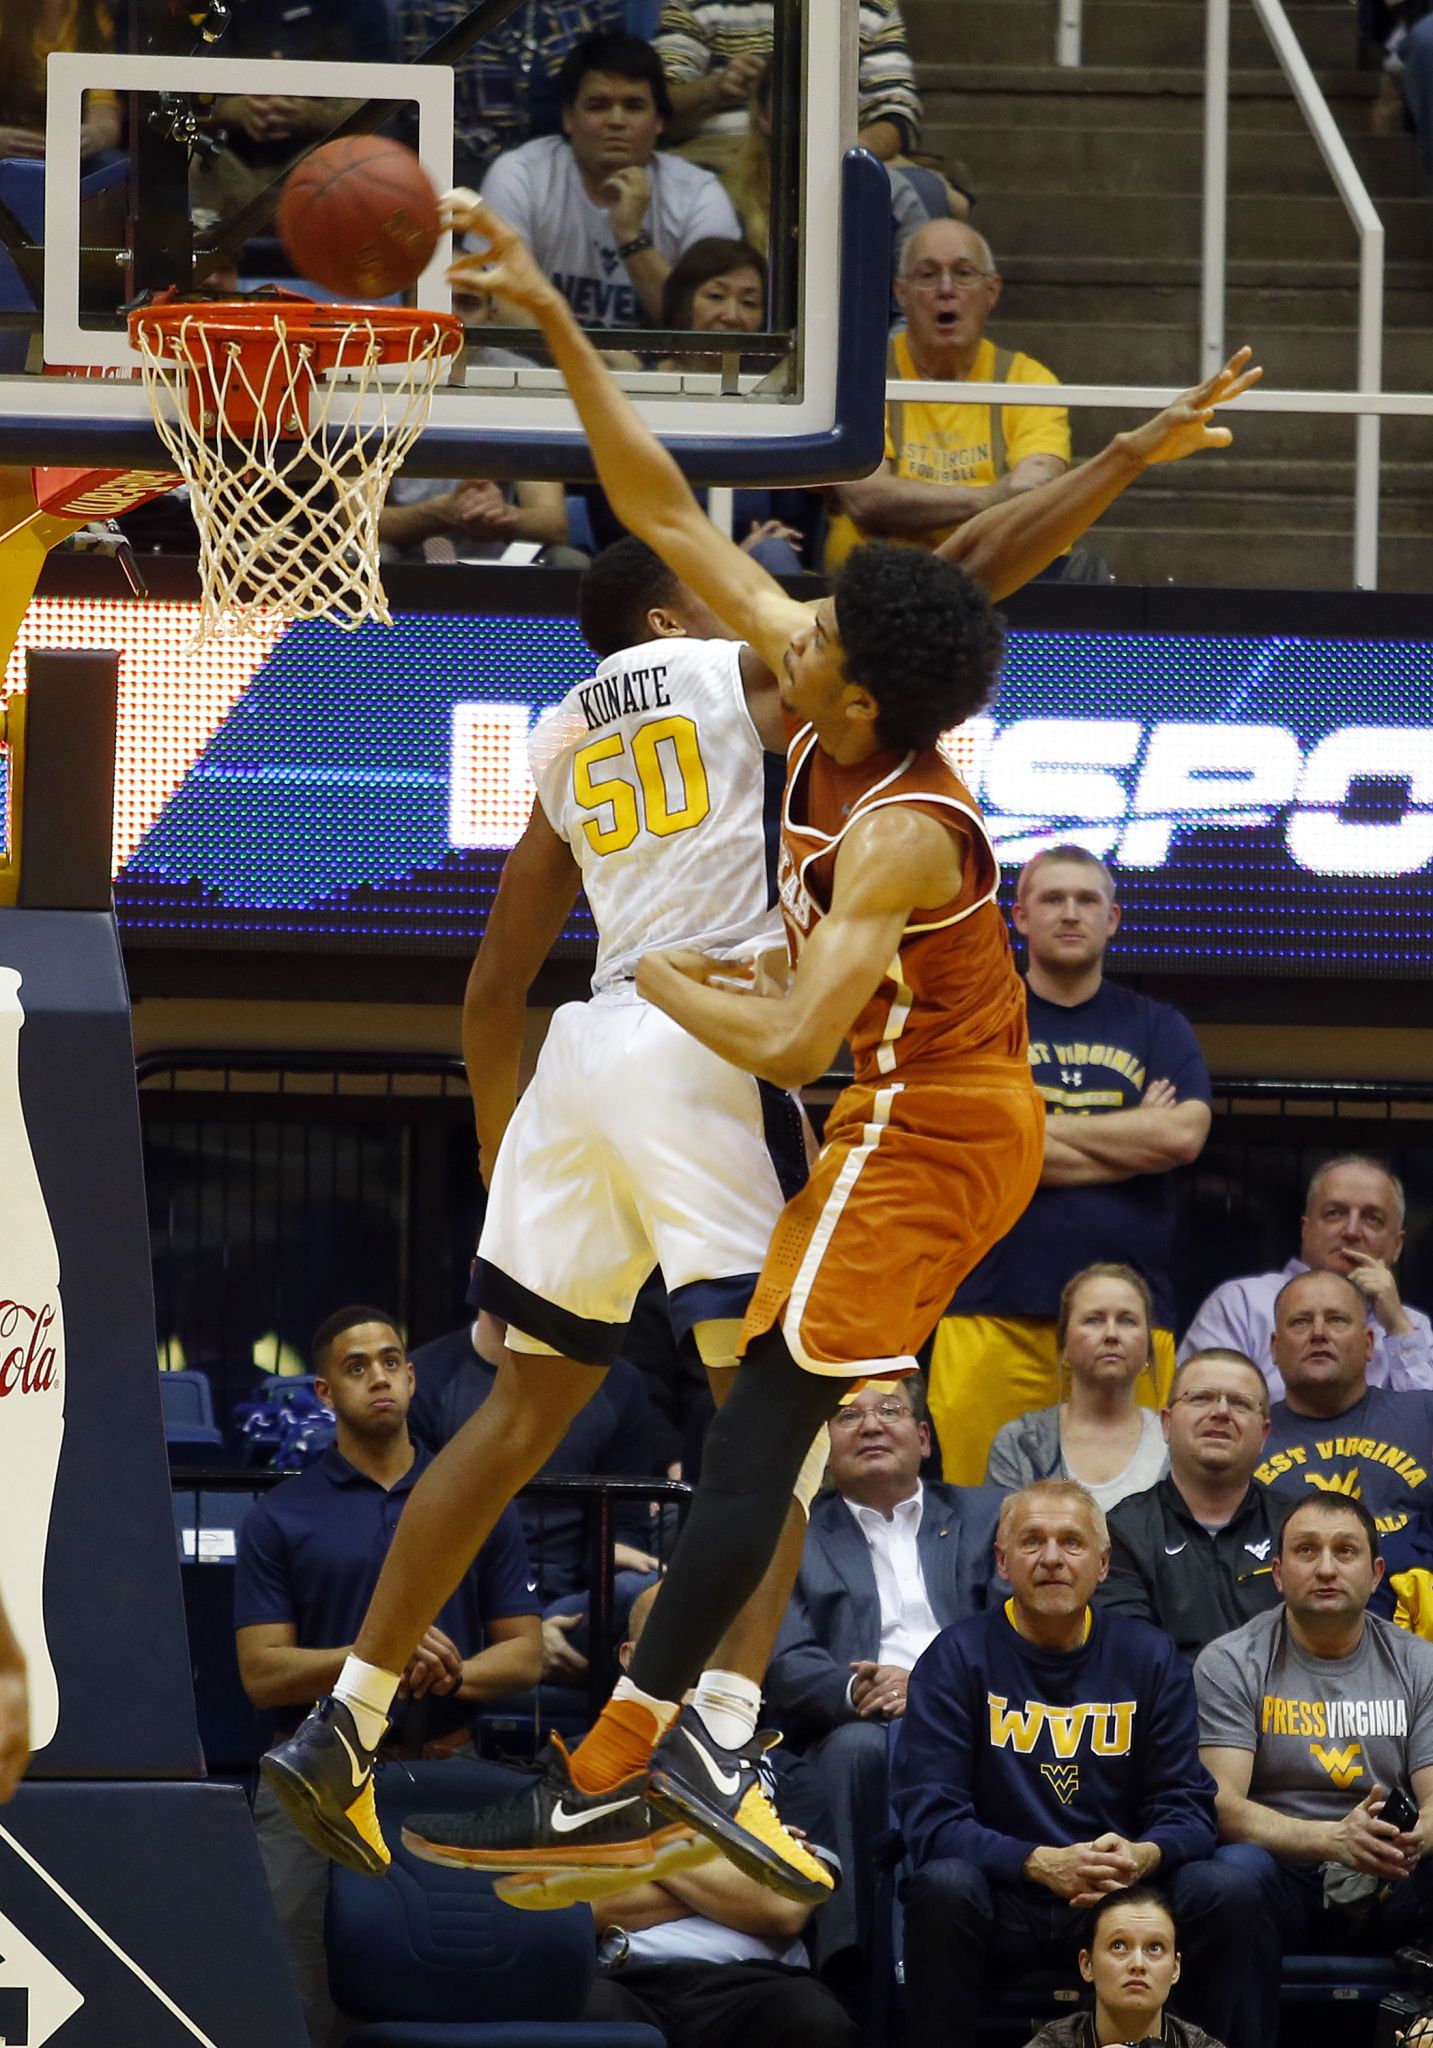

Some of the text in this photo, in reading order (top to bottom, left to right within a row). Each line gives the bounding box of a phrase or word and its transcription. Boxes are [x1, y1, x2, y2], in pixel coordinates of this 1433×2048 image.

[579, 666, 671, 731] KONATE
[573, 714, 711, 857] 50
[1052, 1043, 1146, 1092] VIRGINIA
[1315, 1436, 1428, 1489] VIRGINIA
[988, 1690, 1138, 1759] WVU
[1262, 1695, 1408, 1739] PRESSVIRGINIA
